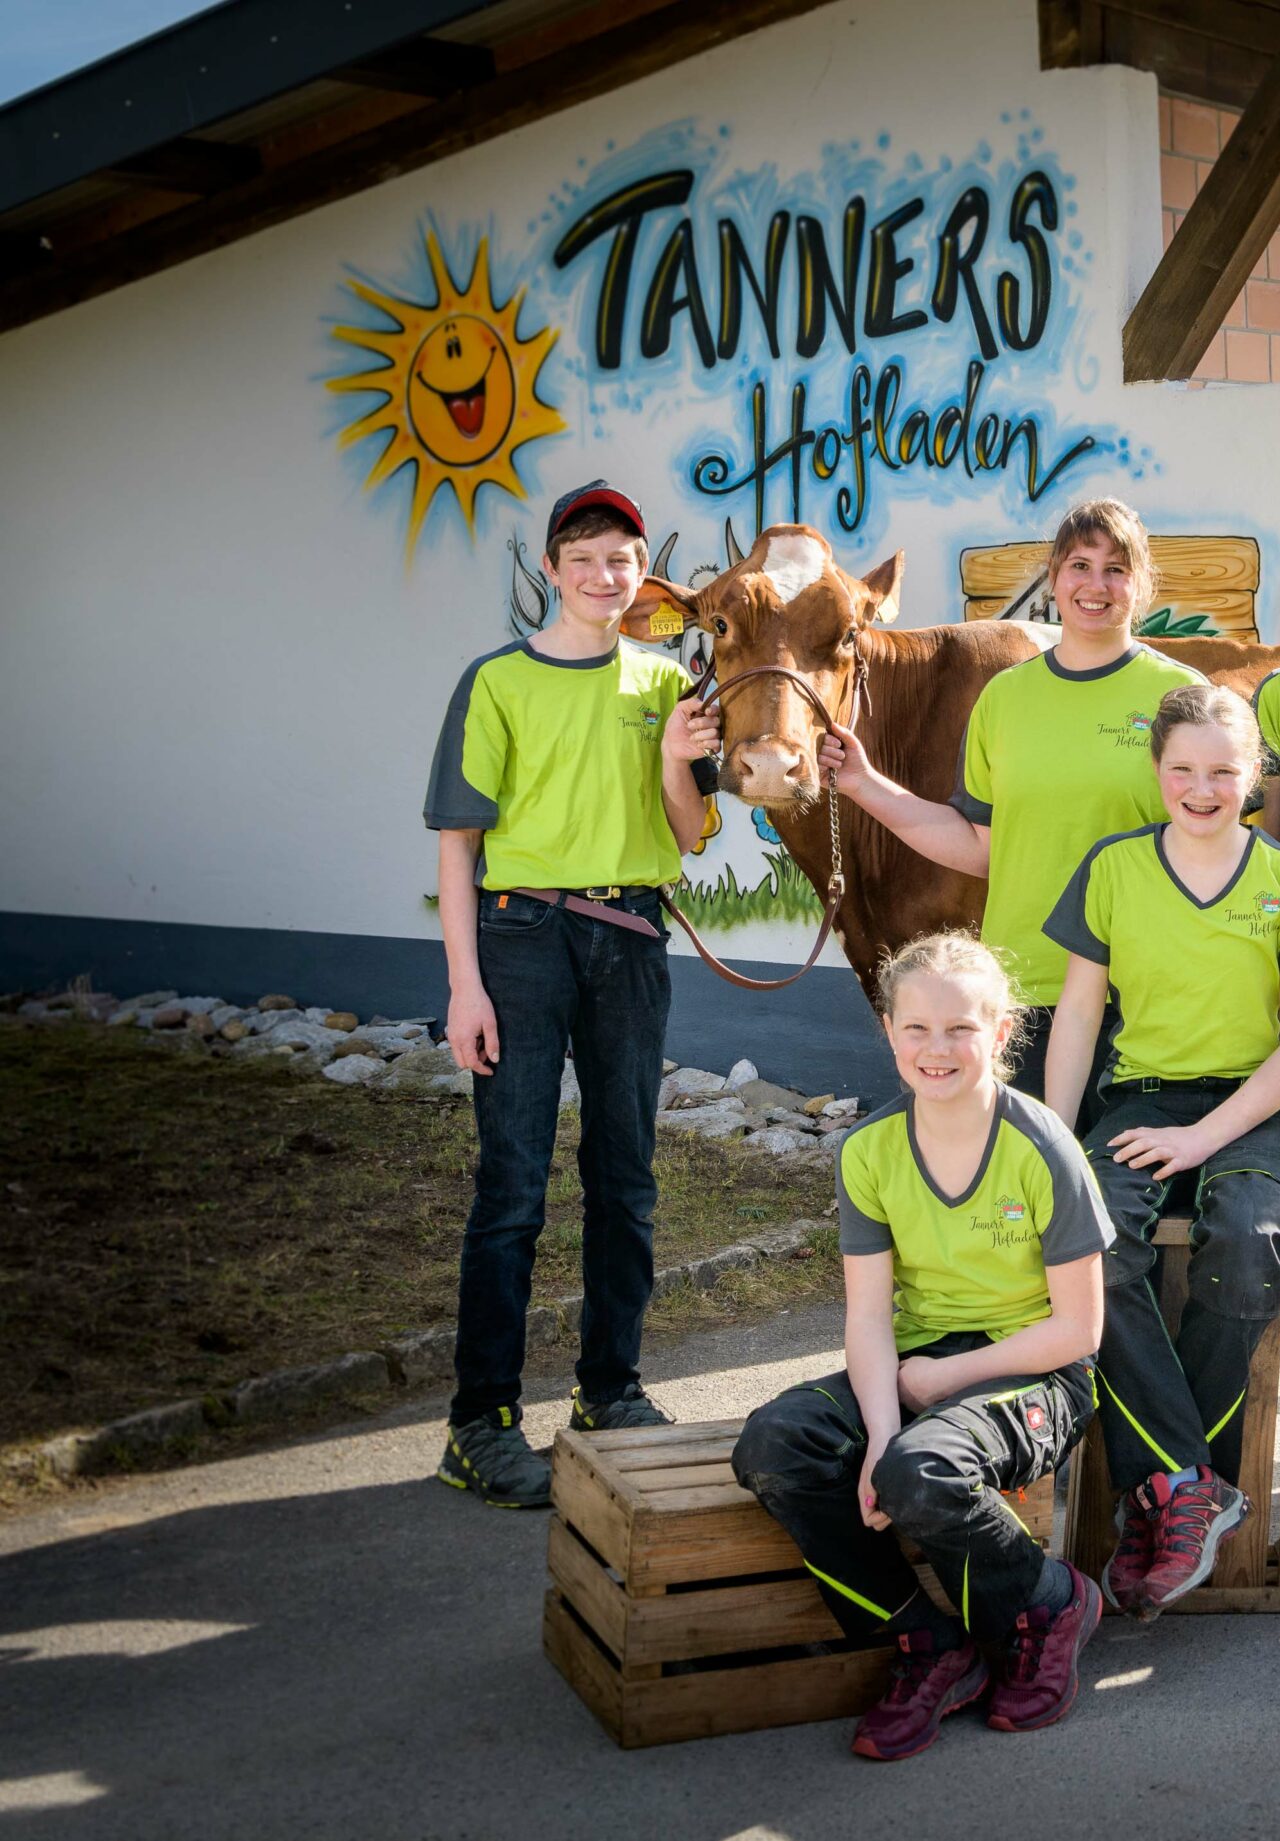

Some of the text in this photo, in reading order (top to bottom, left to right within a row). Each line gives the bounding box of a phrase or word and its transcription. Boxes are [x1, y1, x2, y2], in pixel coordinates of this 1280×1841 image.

[553, 169, 1059, 369] TANNERS
[694, 360, 1096, 537] Hofladen
[653, 624, 675, 635] 2591
[1097, 723, 1130, 735] Tanners
[1114, 735, 1150, 749] Hoflade
[1225, 909, 1262, 922] Tanners
[970, 1215, 1005, 1231] Tanners
